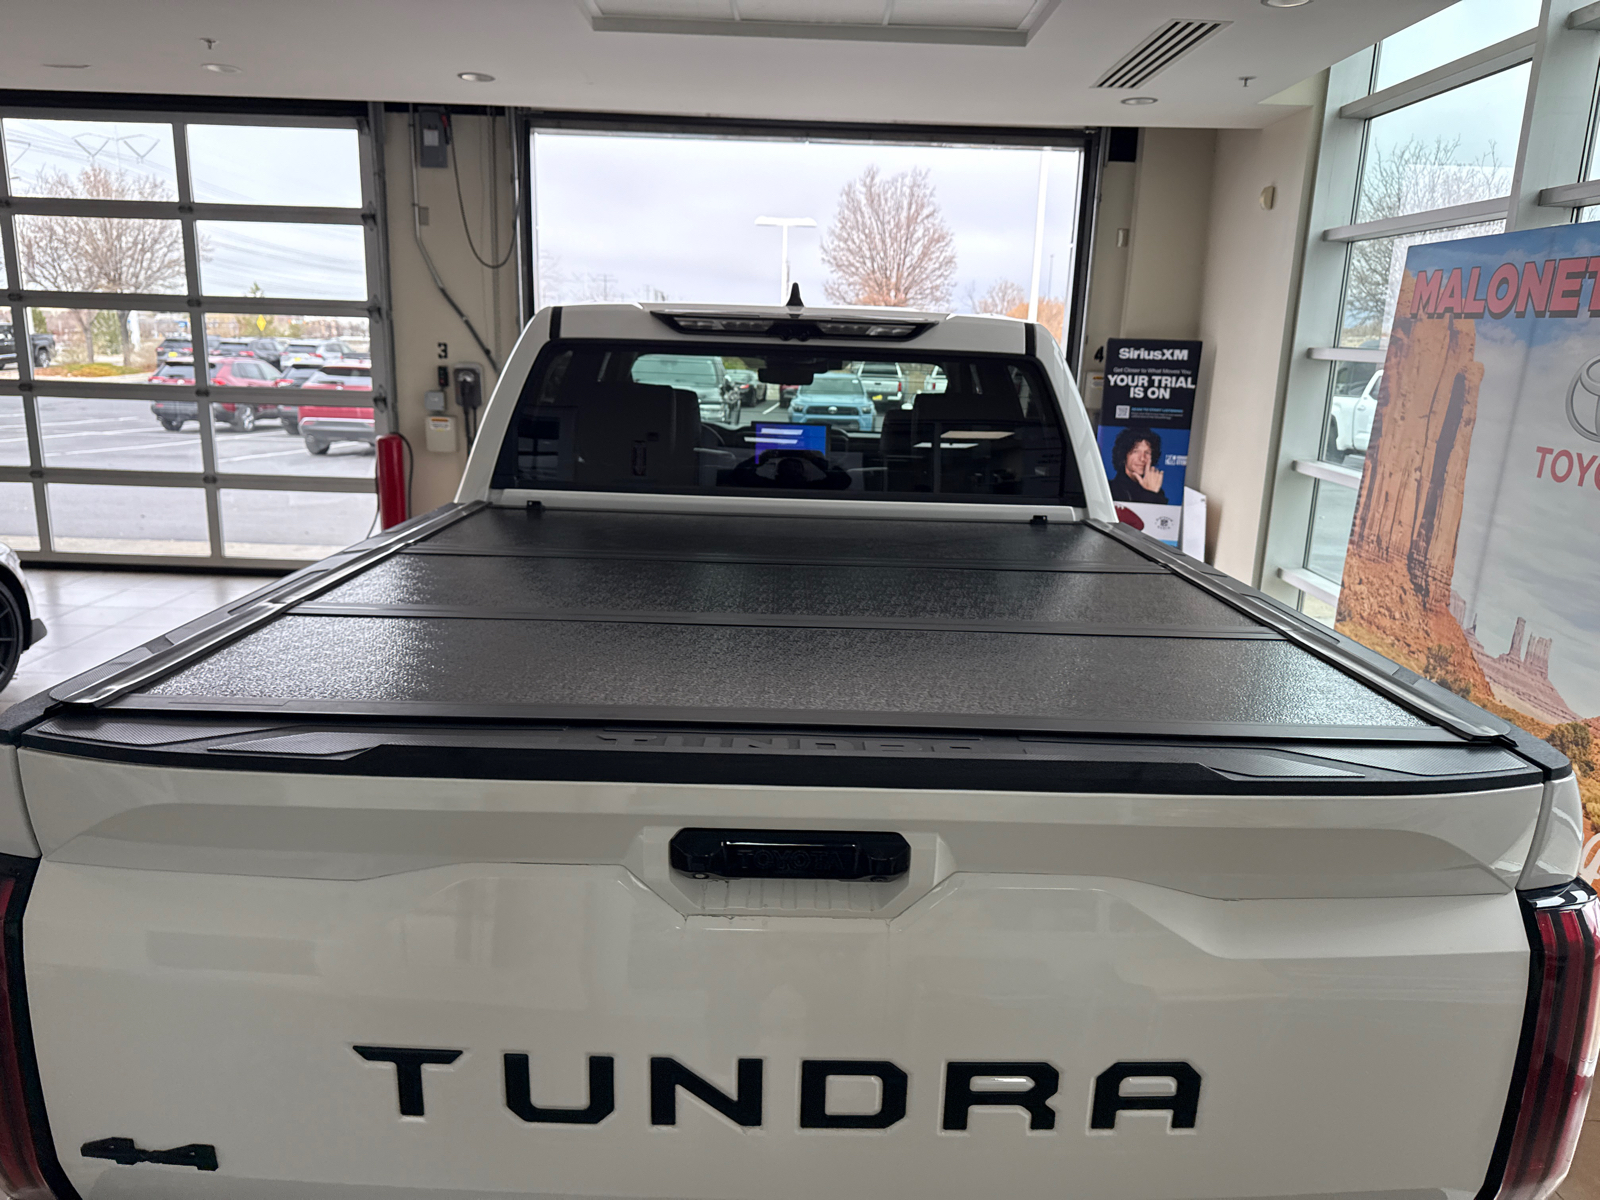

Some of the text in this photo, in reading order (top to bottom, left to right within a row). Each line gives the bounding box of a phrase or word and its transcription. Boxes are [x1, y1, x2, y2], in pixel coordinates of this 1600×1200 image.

[437, 342, 448, 359] 3
[1094, 346, 1104, 363] 4
[1118, 347, 1189, 361] SiriusXM
[1107, 374, 1196, 389] YOUR TRIAL
[1130, 387, 1171, 400] IS ON
[1536, 446, 1600, 491] TOY
[737, 849, 845, 870] TOYOTA
[352, 1045, 1202, 1130] TUNDRA
